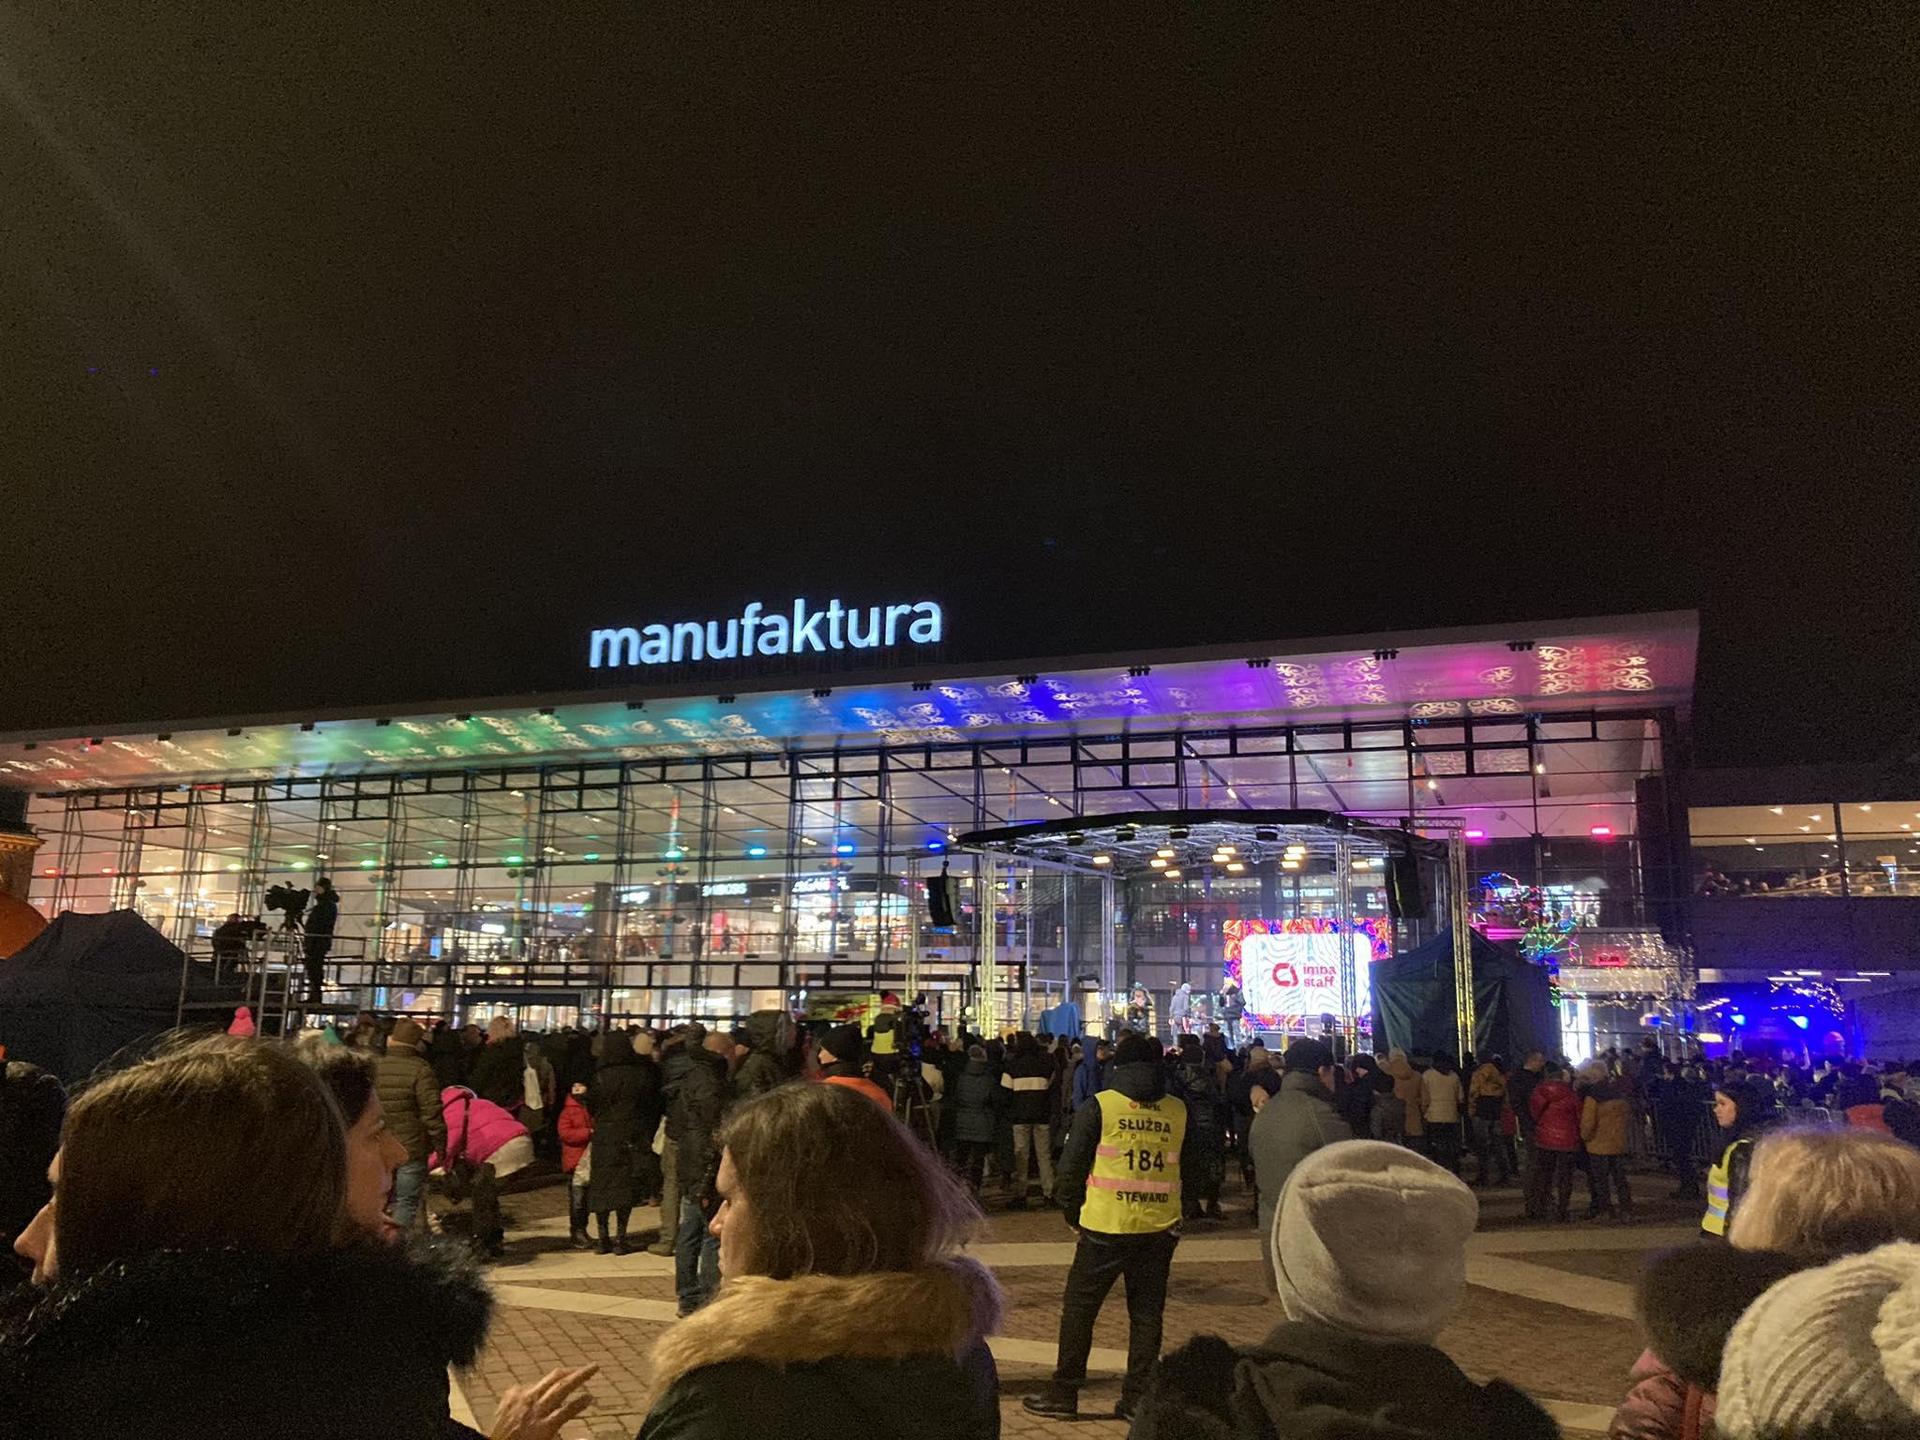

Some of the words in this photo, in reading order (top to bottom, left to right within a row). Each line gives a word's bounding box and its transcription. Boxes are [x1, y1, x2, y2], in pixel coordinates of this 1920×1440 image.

[590, 599, 943, 668] manufaktura
[1303, 975, 1334, 988] staff
[1119, 1118, 1171, 1133] SŁUŻBA
[1124, 1149, 1165, 1172] 184
[1117, 1191, 1168, 1203] STEWARD
